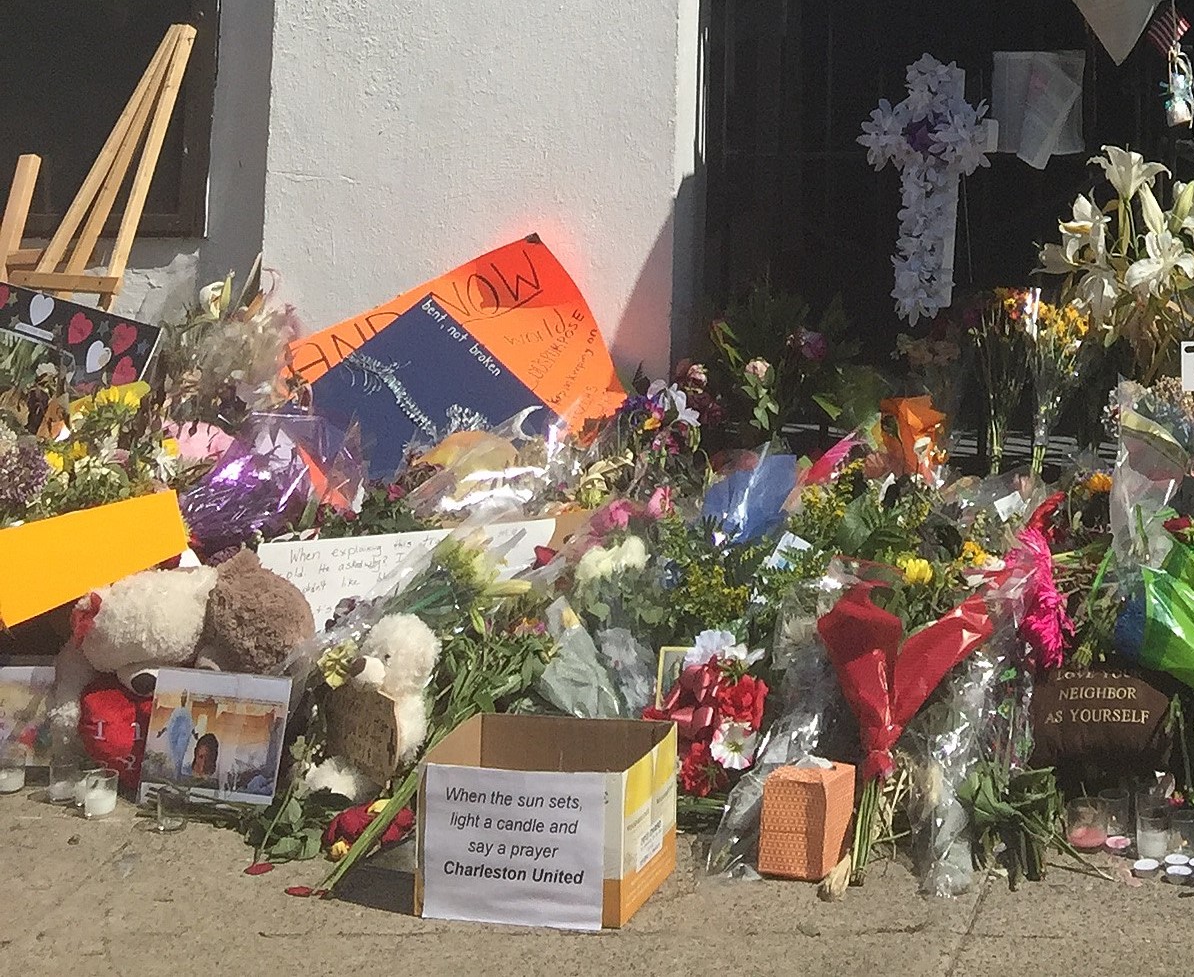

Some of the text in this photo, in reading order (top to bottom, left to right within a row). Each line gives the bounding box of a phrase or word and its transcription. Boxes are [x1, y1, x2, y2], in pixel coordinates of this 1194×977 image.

[431, 250, 543, 317] NOW
[447, 326, 468, 342] not
[469, 343, 501, 376] broken
[290, 547, 320, 564] When
[1059, 686, 1137, 701] NEIGHBOR
[1044, 708, 1150, 725] AS YOURSELF
[445, 786, 583, 812] When the sun sets,
[450, 812, 578, 835] light a candle and
[468, 841, 559, 859] say a prayer
[444, 860, 584, 885] Charleston United
